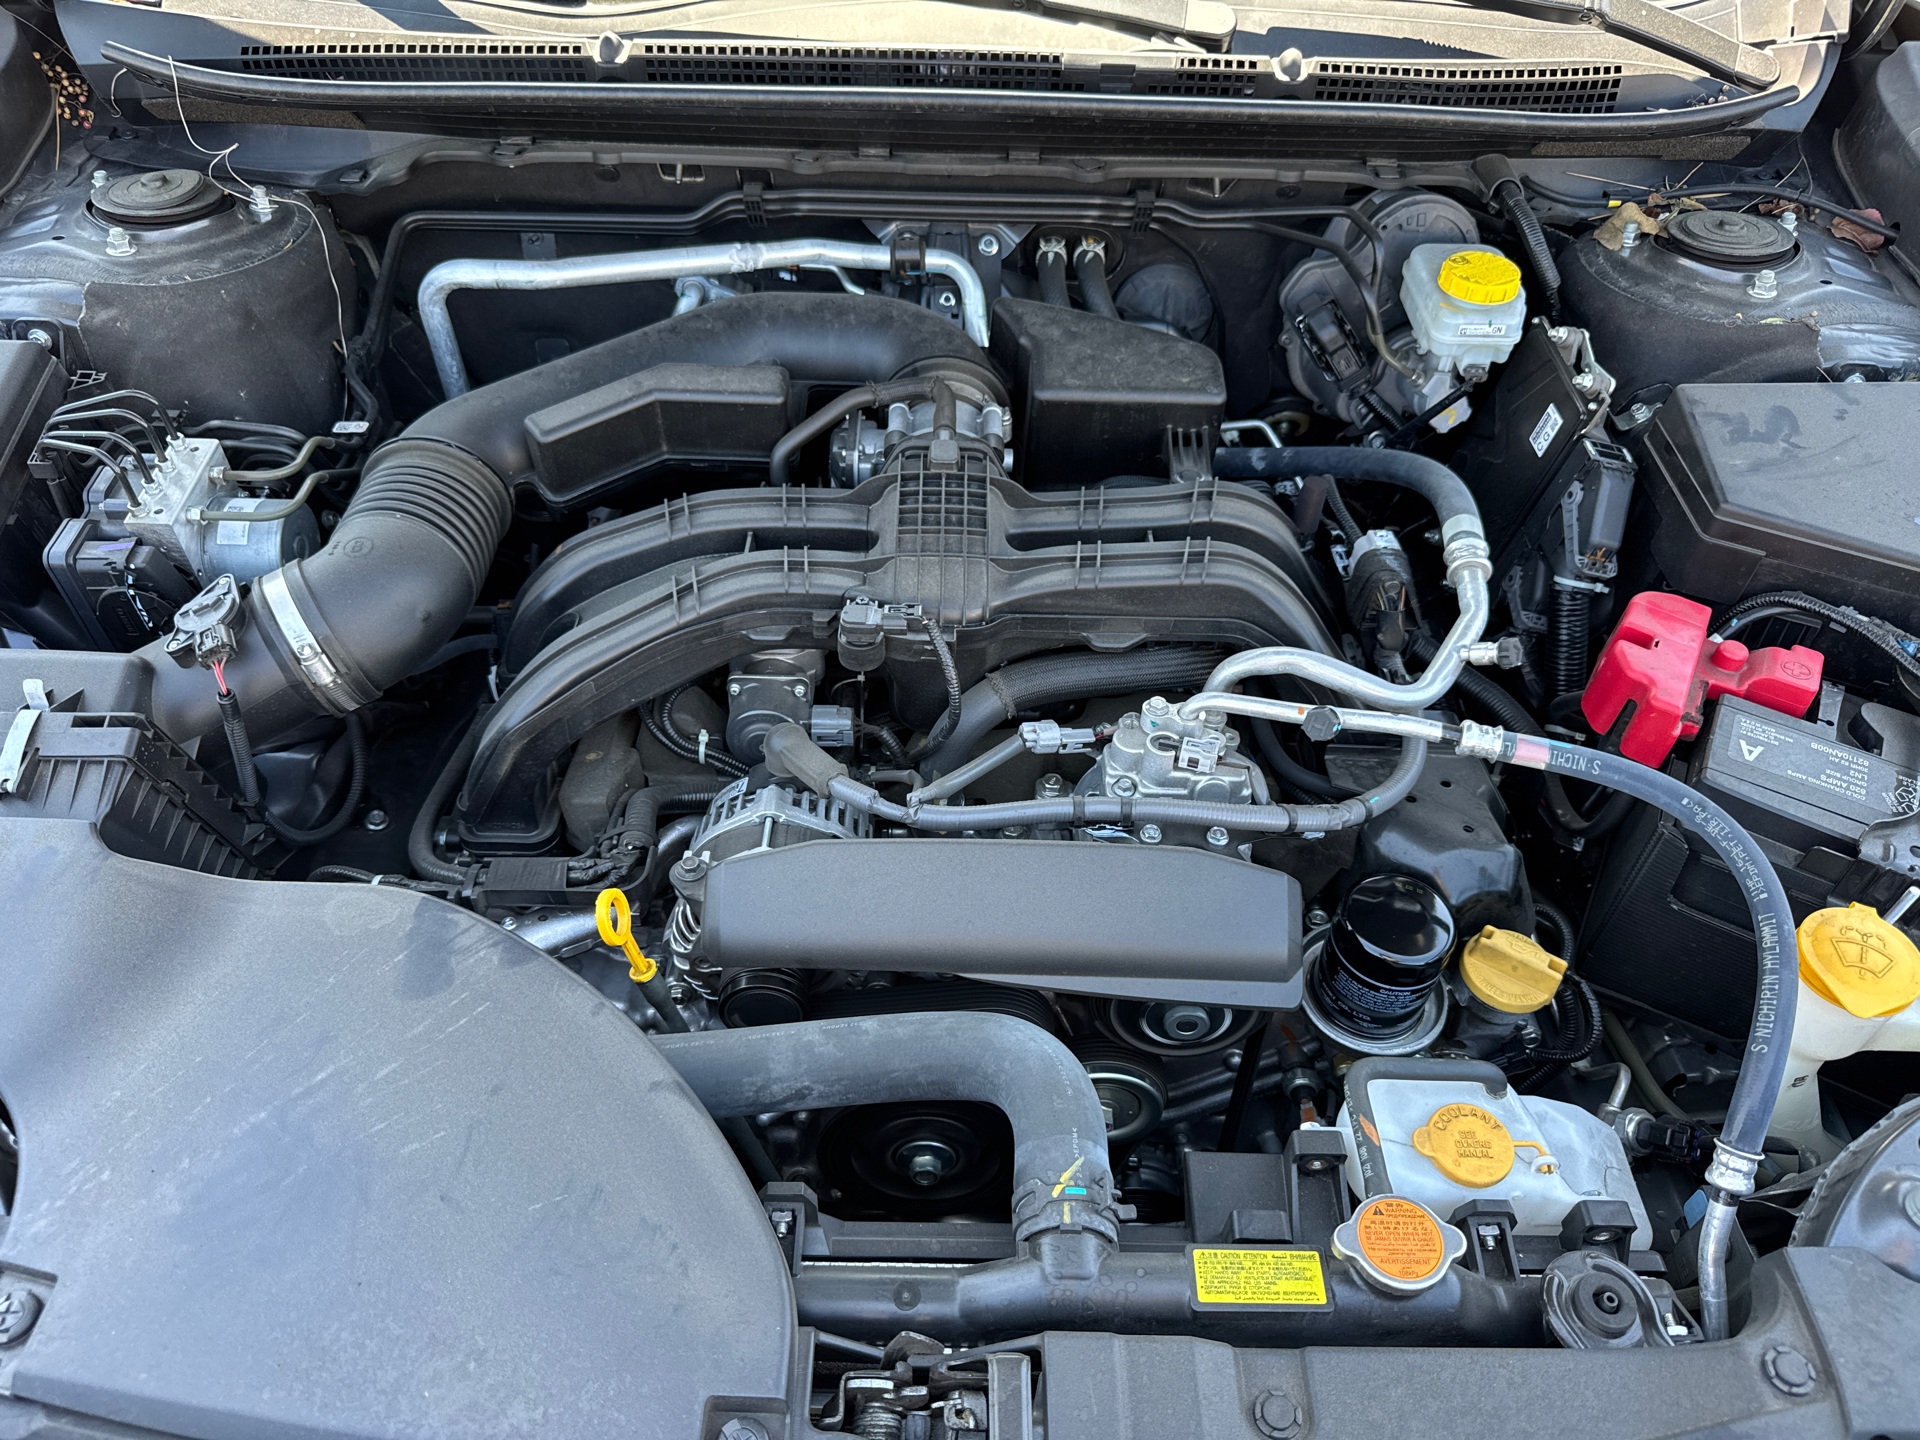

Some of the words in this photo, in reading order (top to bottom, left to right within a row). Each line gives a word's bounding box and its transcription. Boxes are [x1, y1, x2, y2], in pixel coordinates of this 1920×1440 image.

[1492, 326, 1502, 334] GN
[1739, 739, 1764, 762] A
[1810, 742, 1869, 766] 82110AN00B
[1787, 770, 1807, 780] AMPS
[1826, 768, 1840, 778] SIZE
[1850, 770, 1868, 780] LN2
[1808, 776, 1844, 794] CRANKING
[1820, 774, 1848, 788] AMPS
[1842, 776, 1867, 786] GROUP
[1850, 784, 1866, 794] 620
[1846, 790, 1866, 800] COLD
[1758, 912, 1780, 970] HYLAMMIT
[1433, 1104, 1503, 1132] COOLANT
[1458, 1130, 1477, 1140] SEE
[1457, 1149, 1494, 1160] MANUAL
